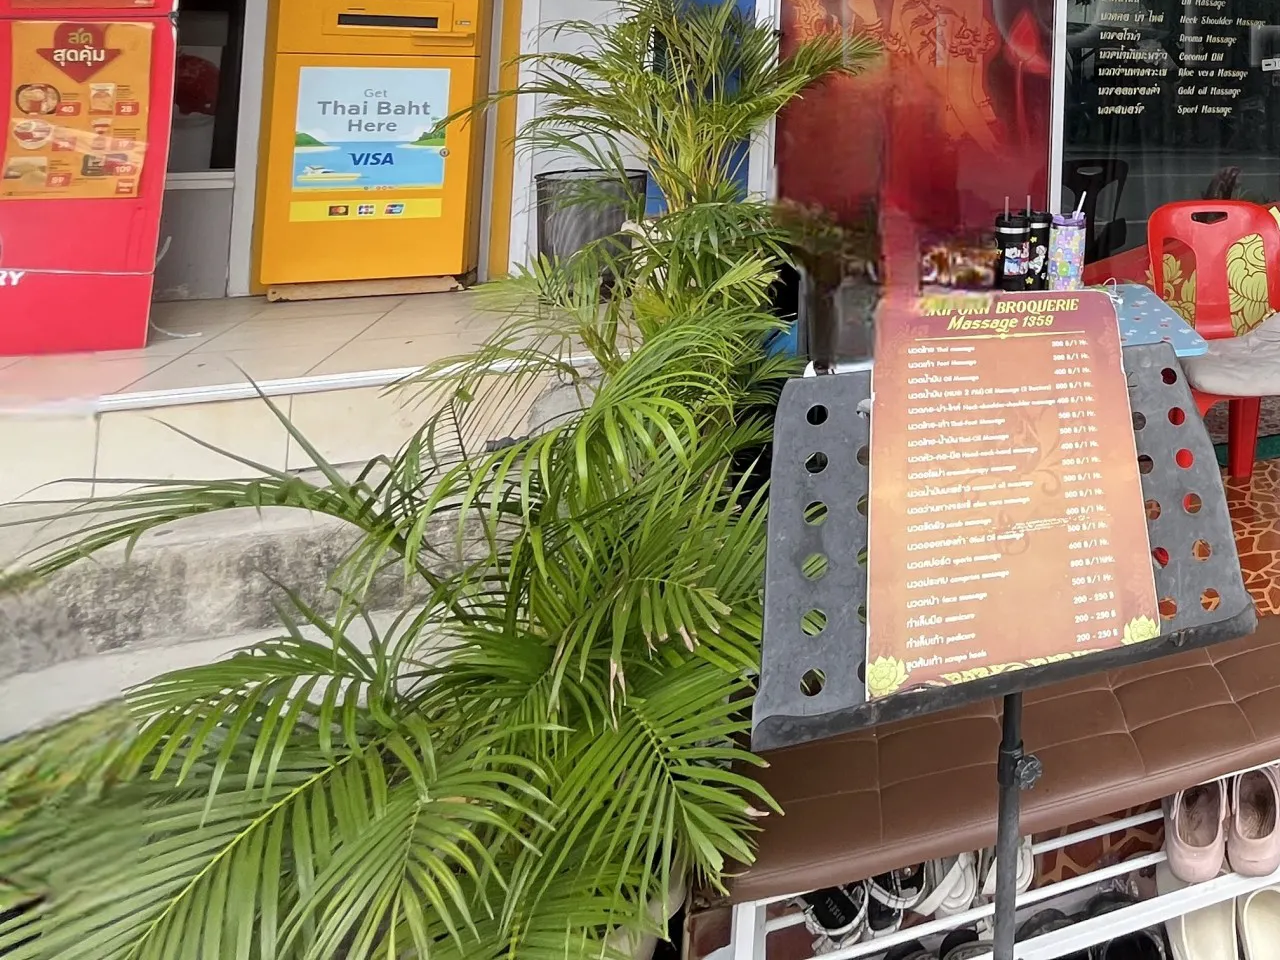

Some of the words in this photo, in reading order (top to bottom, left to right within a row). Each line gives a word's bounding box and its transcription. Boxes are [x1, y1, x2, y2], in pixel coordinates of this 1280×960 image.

[1201, 16, 1233, 26] Shoulder
[1236, 17, 1266, 29] Massage
[1206, 34, 1237, 47] Massage
[53, 45, 105, 67] สุดคุ้ม
[1178, 51, 1208, 62] Coconut
[1217, 68, 1248, 81] Massage
[364, 88, 388, 98] Get
[1210, 86, 1241, 99] Massage
[317, 101, 368, 116] Thai
[377, 101, 431, 116] Baht
[1177, 105, 1198, 115] Sport
[1201, 105, 1232, 118] Massage
[348, 119, 397, 132] Here
[348, 152, 394, 165] VISA
[996, 298, 1079, 316] BROQUERIE
[947, 316, 1017, 333] Massage
[1022, 315, 1054, 327] 1359
